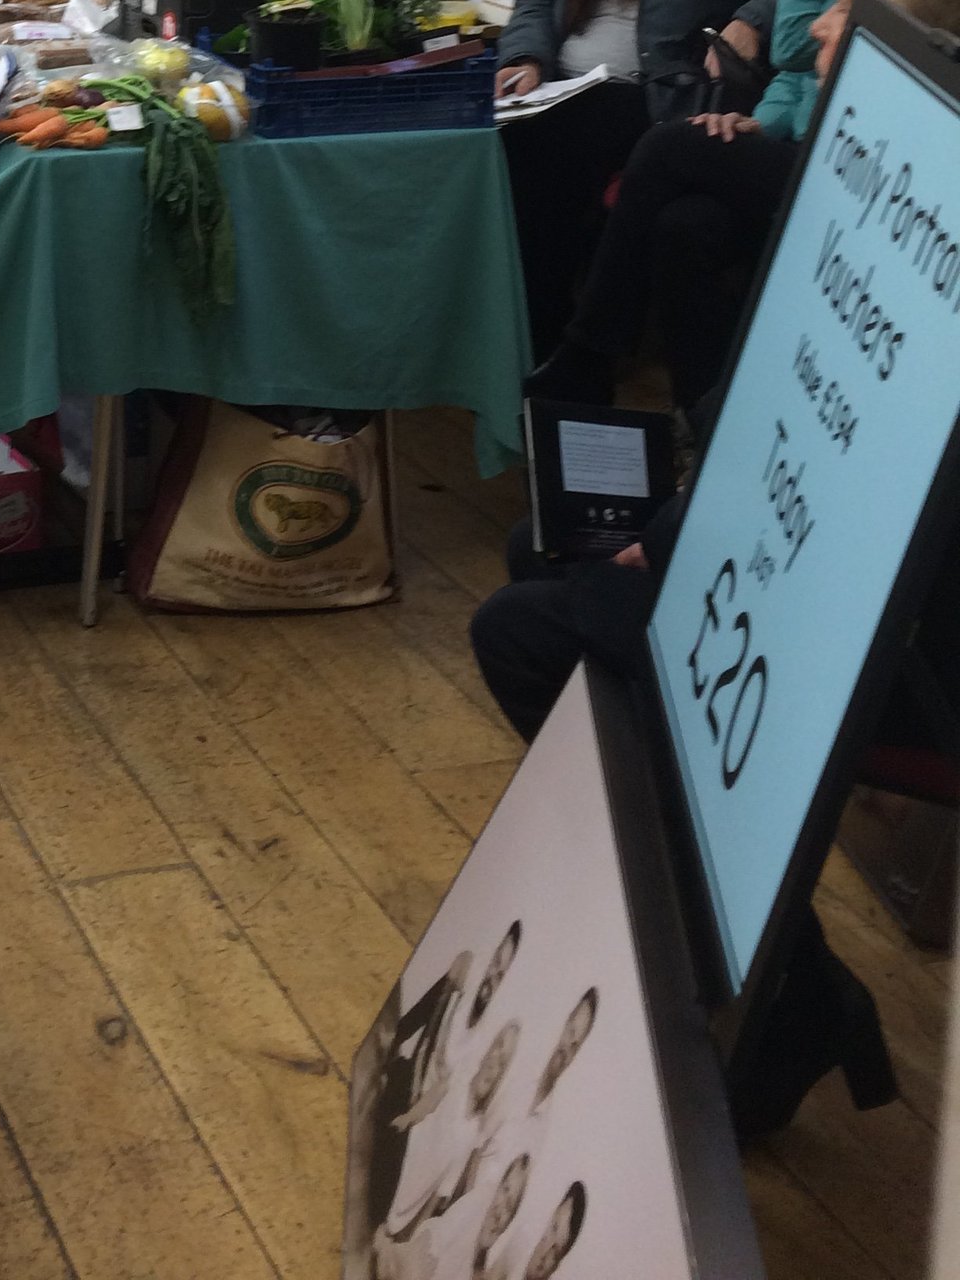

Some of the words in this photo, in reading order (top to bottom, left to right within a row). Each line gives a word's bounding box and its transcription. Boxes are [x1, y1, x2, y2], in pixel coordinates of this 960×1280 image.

[824, 105, 891, 230] Family
[792, 332, 823, 403] Value
[813, 218, 906, 382] Vouchers
[762, 417, 816, 574] Today
[688, 557, 769, 791] £20
